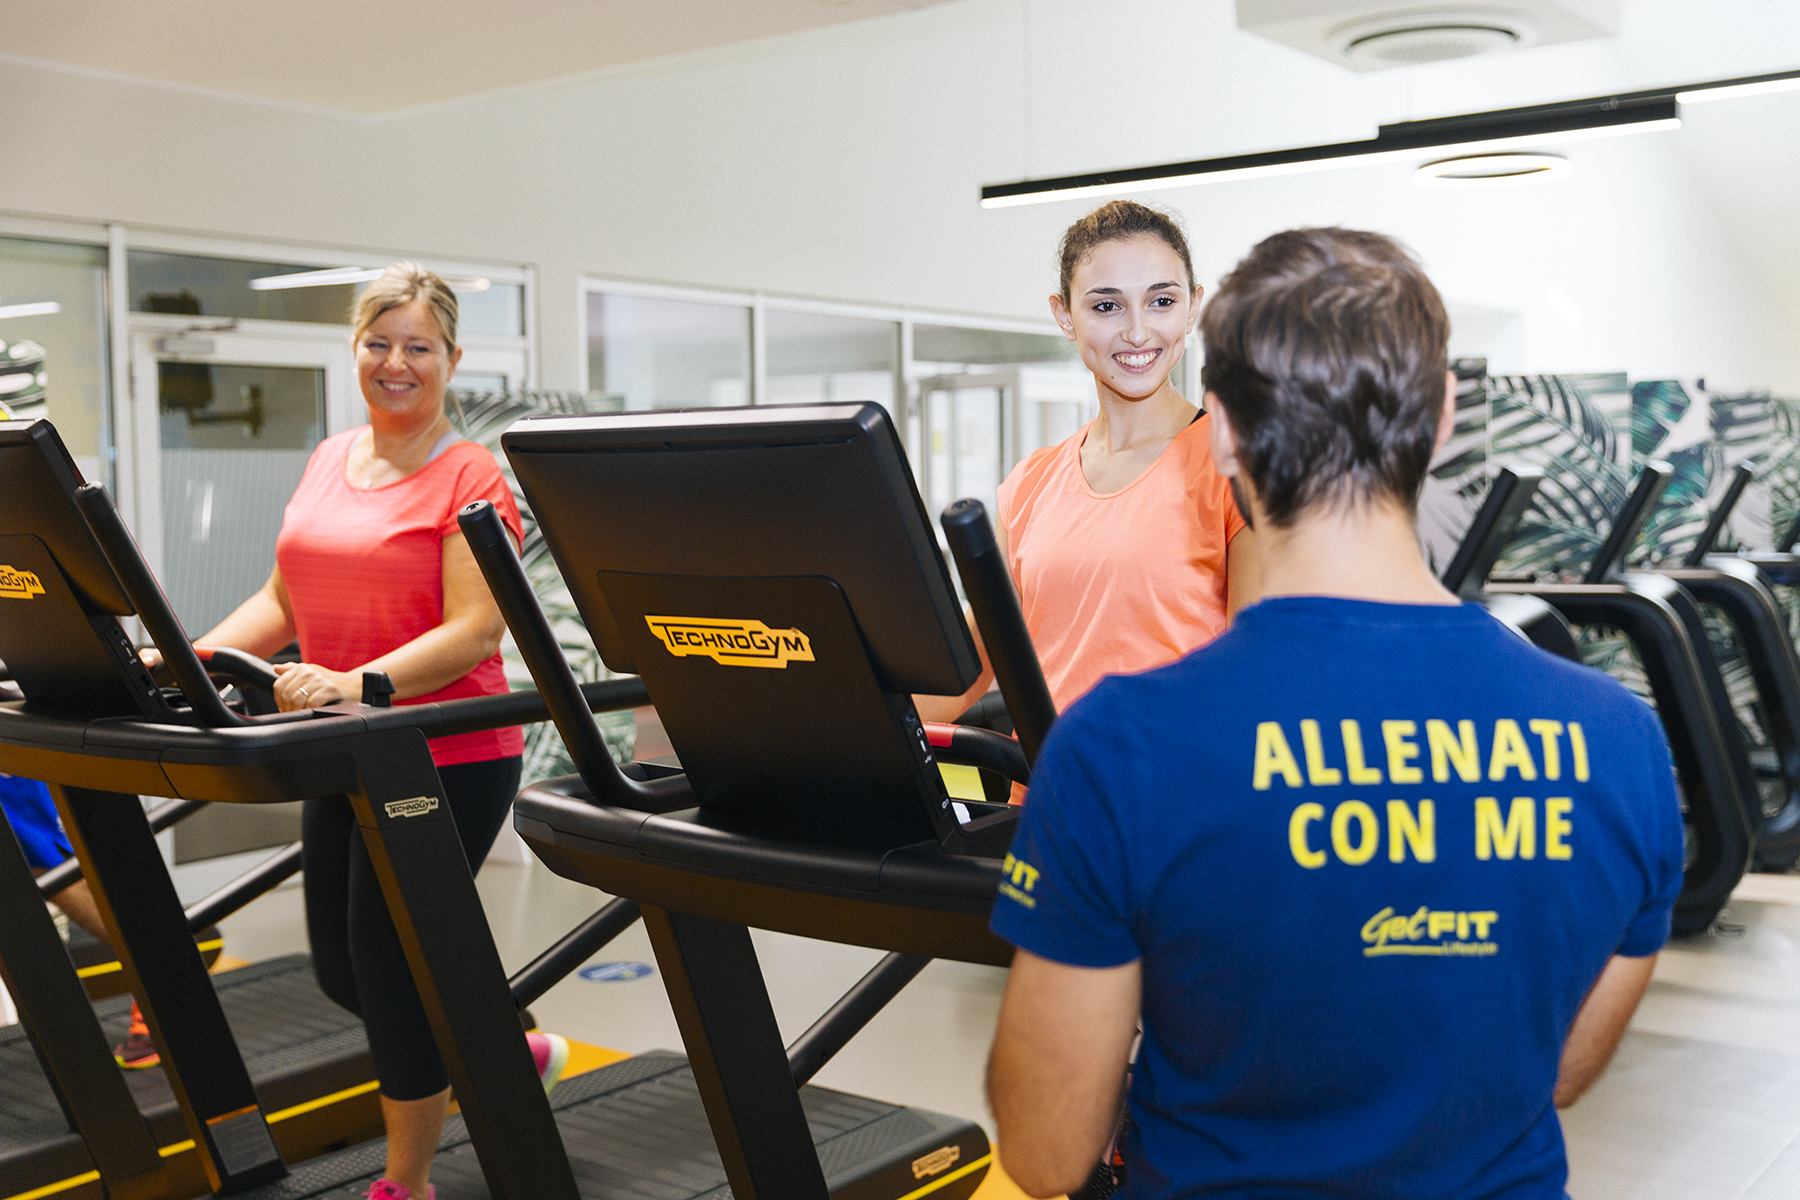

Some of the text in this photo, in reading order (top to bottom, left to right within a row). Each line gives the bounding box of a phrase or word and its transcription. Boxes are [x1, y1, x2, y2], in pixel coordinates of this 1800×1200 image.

[1252, 718, 1590, 791] ALLENATI
[1288, 797, 1573, 869] CON ME
